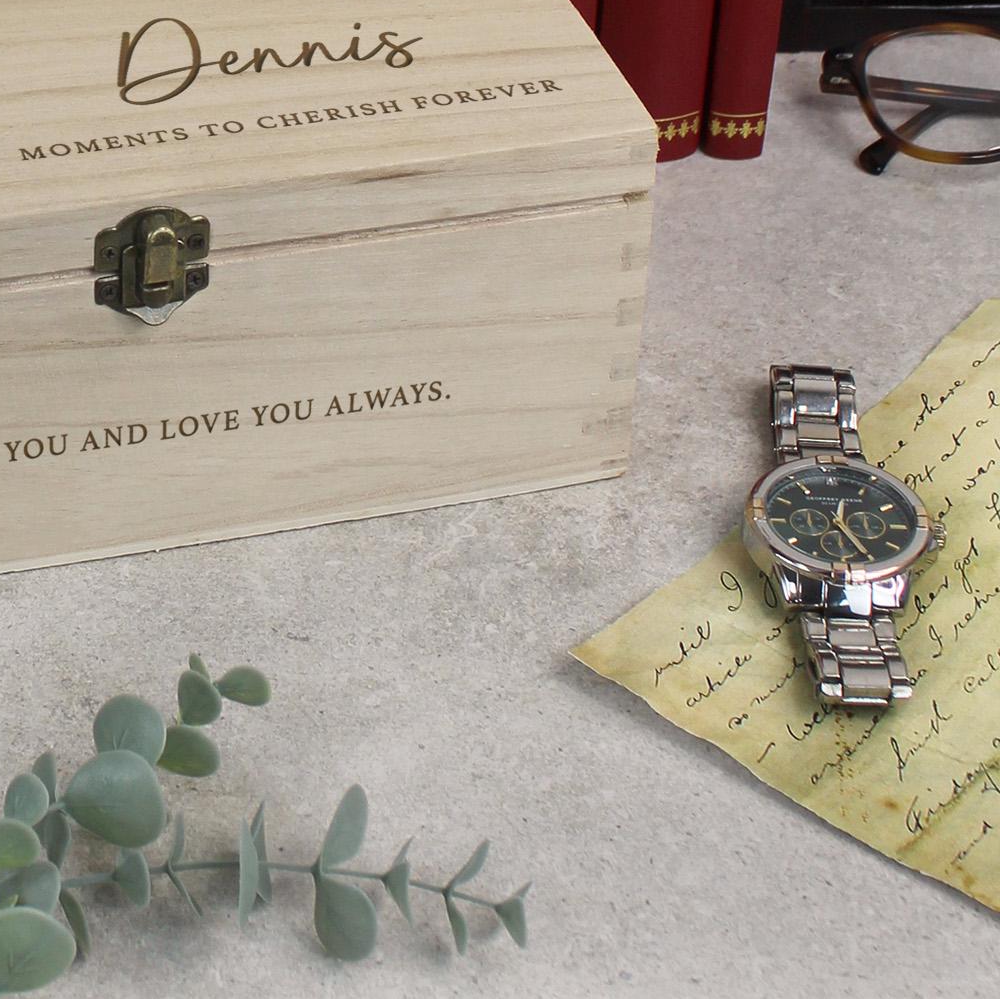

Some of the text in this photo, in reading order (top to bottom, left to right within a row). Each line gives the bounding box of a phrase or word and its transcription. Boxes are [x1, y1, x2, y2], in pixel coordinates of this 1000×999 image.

[116, 17, 423, 106] Dennis
[20, 78, 564, 162] MOMENTS TO CHERISH FOREVER
[4, 434, 69, 463] YOU
[80, 423, 149, 452] AND
[160, 410, 241, 441] LOVE
[251, 398, 315, 427] YOU
[324, 381, 452, 417] ALWAYS.
